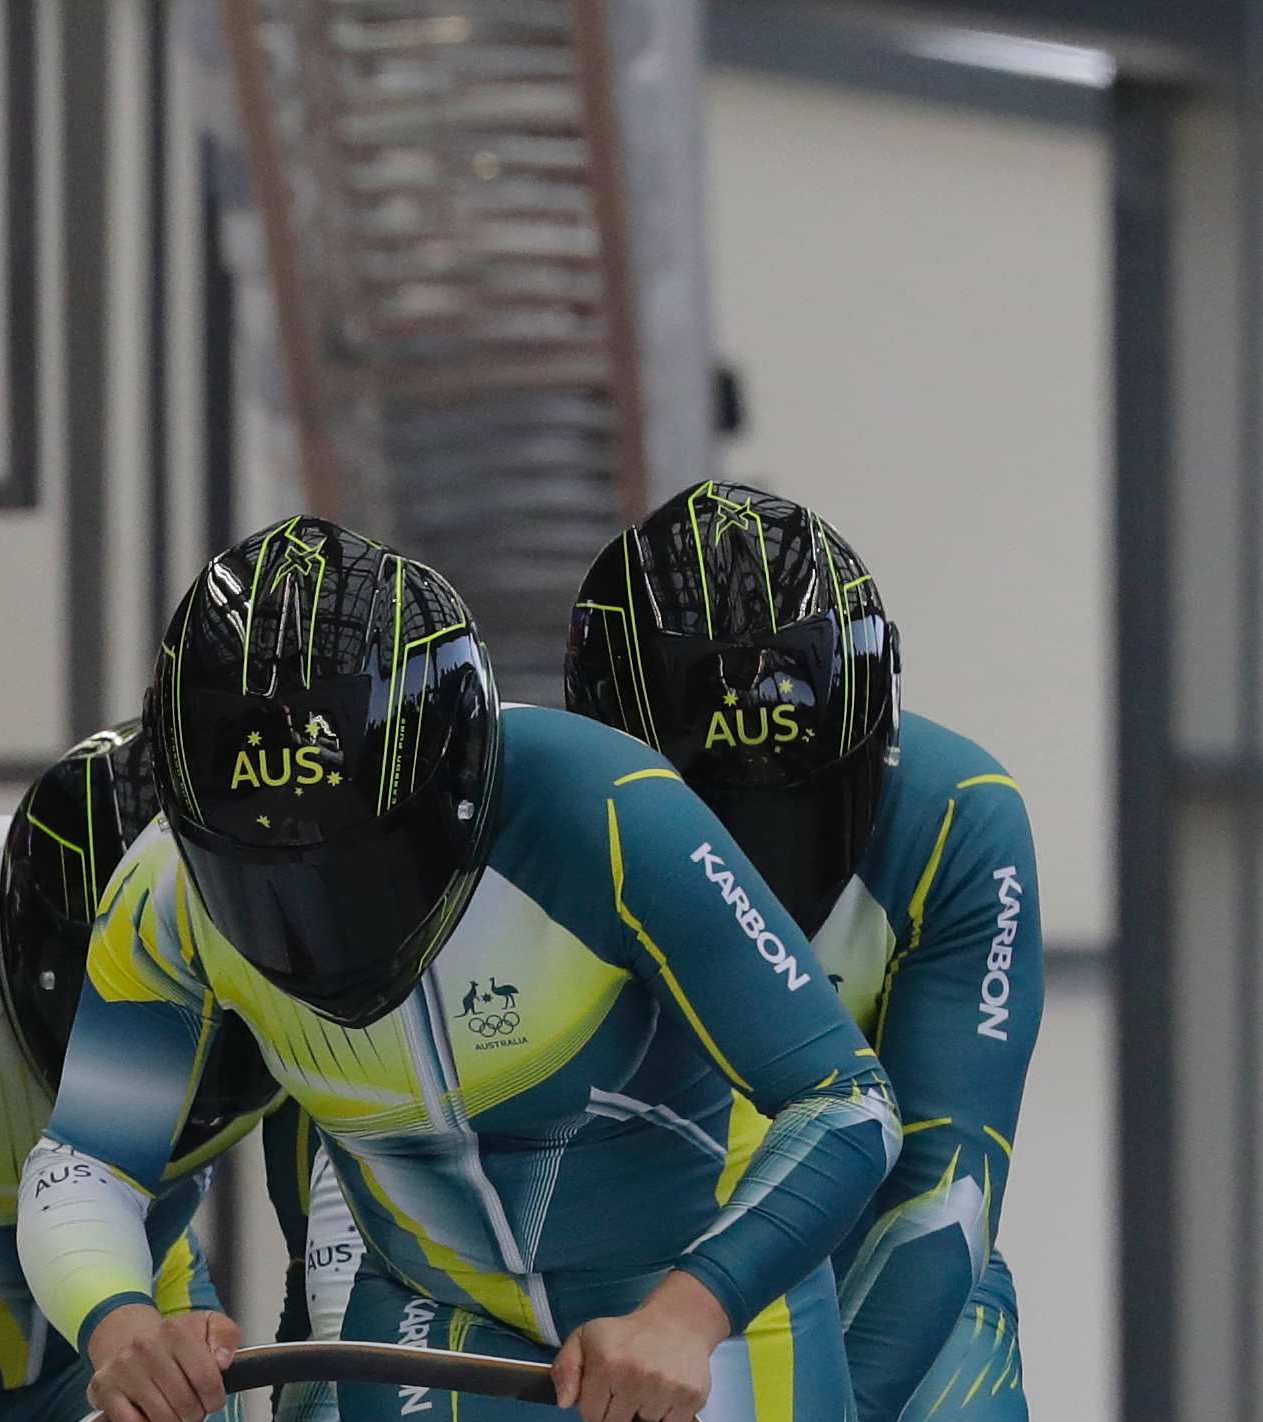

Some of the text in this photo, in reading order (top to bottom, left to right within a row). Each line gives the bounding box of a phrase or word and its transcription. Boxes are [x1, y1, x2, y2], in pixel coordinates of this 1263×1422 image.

[705, 703, 799, 749] AUS
[230, 745, 324, 790] AUS
[690, 842, 812, 992] KARBON
[976, 865, 1023, 1041] KARBON
[475, 1036, 529, 1051] AUSTRALIA
[35, 1164, 92, 1198] AUS
[307, 1243, 353, 1278] AUS
